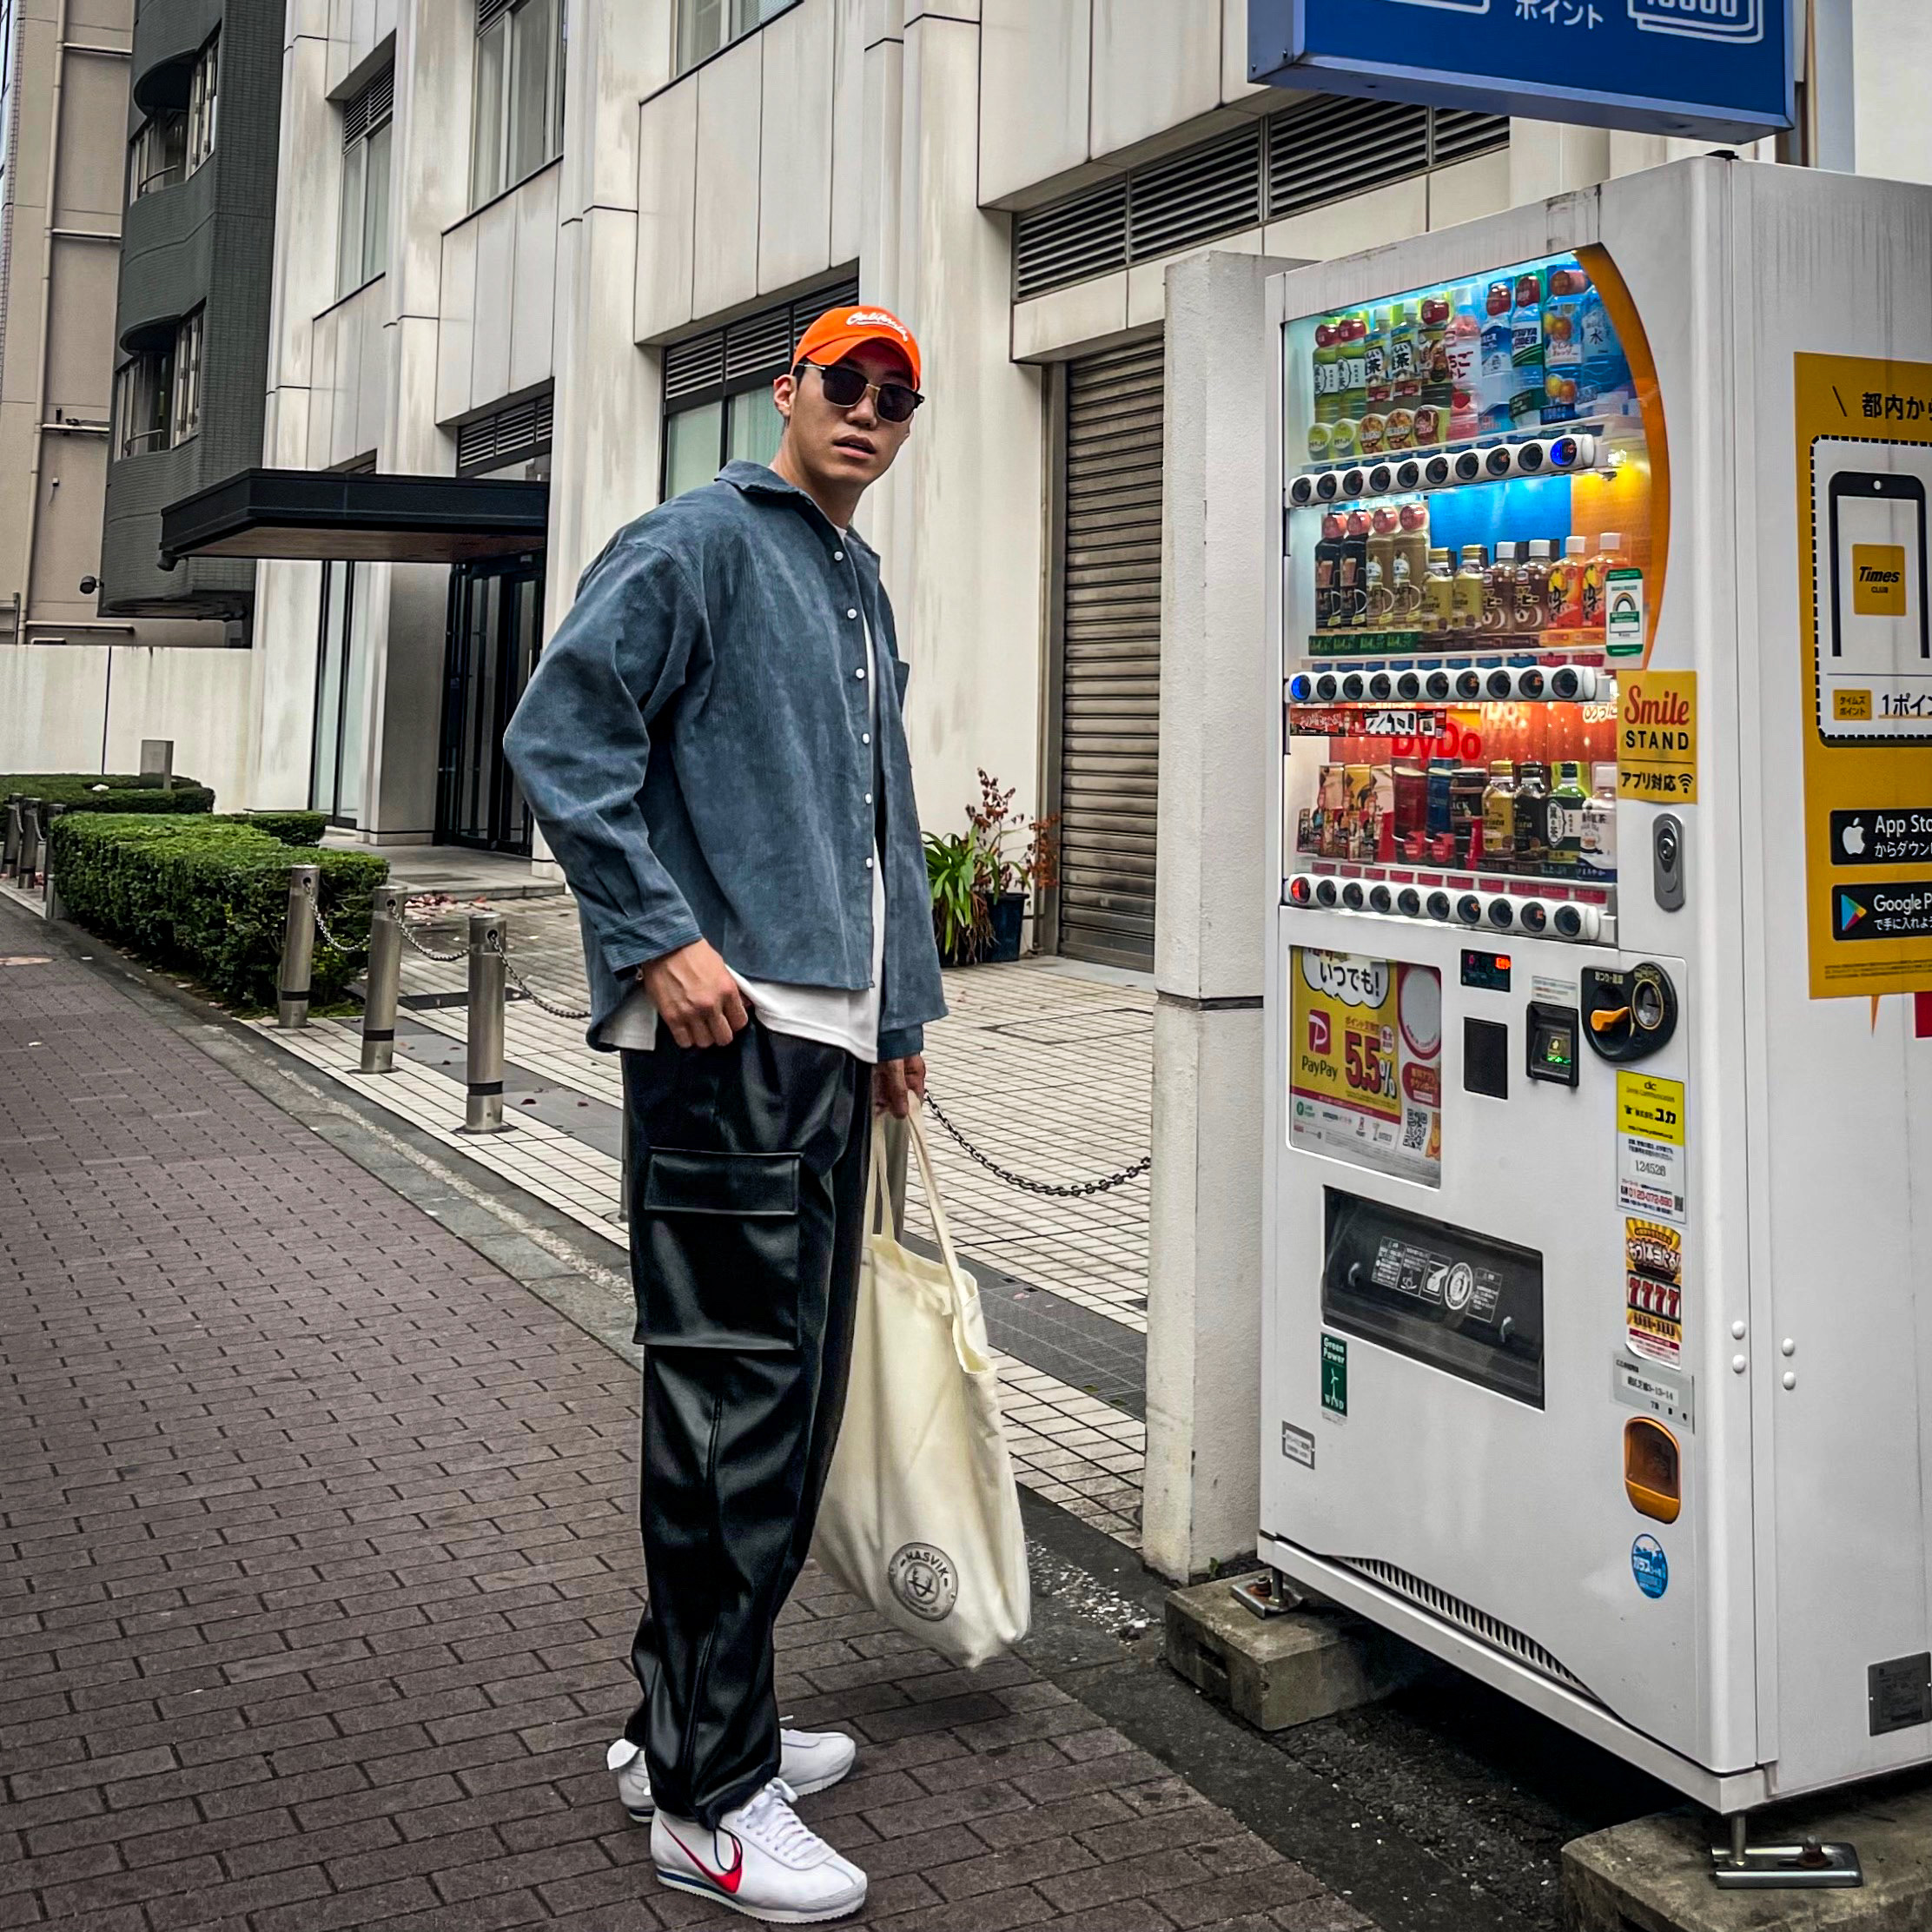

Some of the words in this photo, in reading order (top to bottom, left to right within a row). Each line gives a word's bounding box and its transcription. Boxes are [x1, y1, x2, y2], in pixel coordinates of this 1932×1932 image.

[1862, 392, 1932, 422] 都内か
[1859, 566, 1901, 583] Times
[1624, 685, 1690, 725] Smile
[1625, 730, 1689, 751] STAND
[1621, 771, 1677, 791] アプリ対応
[1875, 815, 1906, 838] App
[1874, 840, 1932, 857] からダウン
[1873, 892, 1922, 916] Google
[1301, 1055, 1339, 1082] PayPay
[1635, 1159, 1666, 1177] 124528
[1323, 1337, 1345, 1353] Green
[1323, 1346, 1346, 1365] Power
